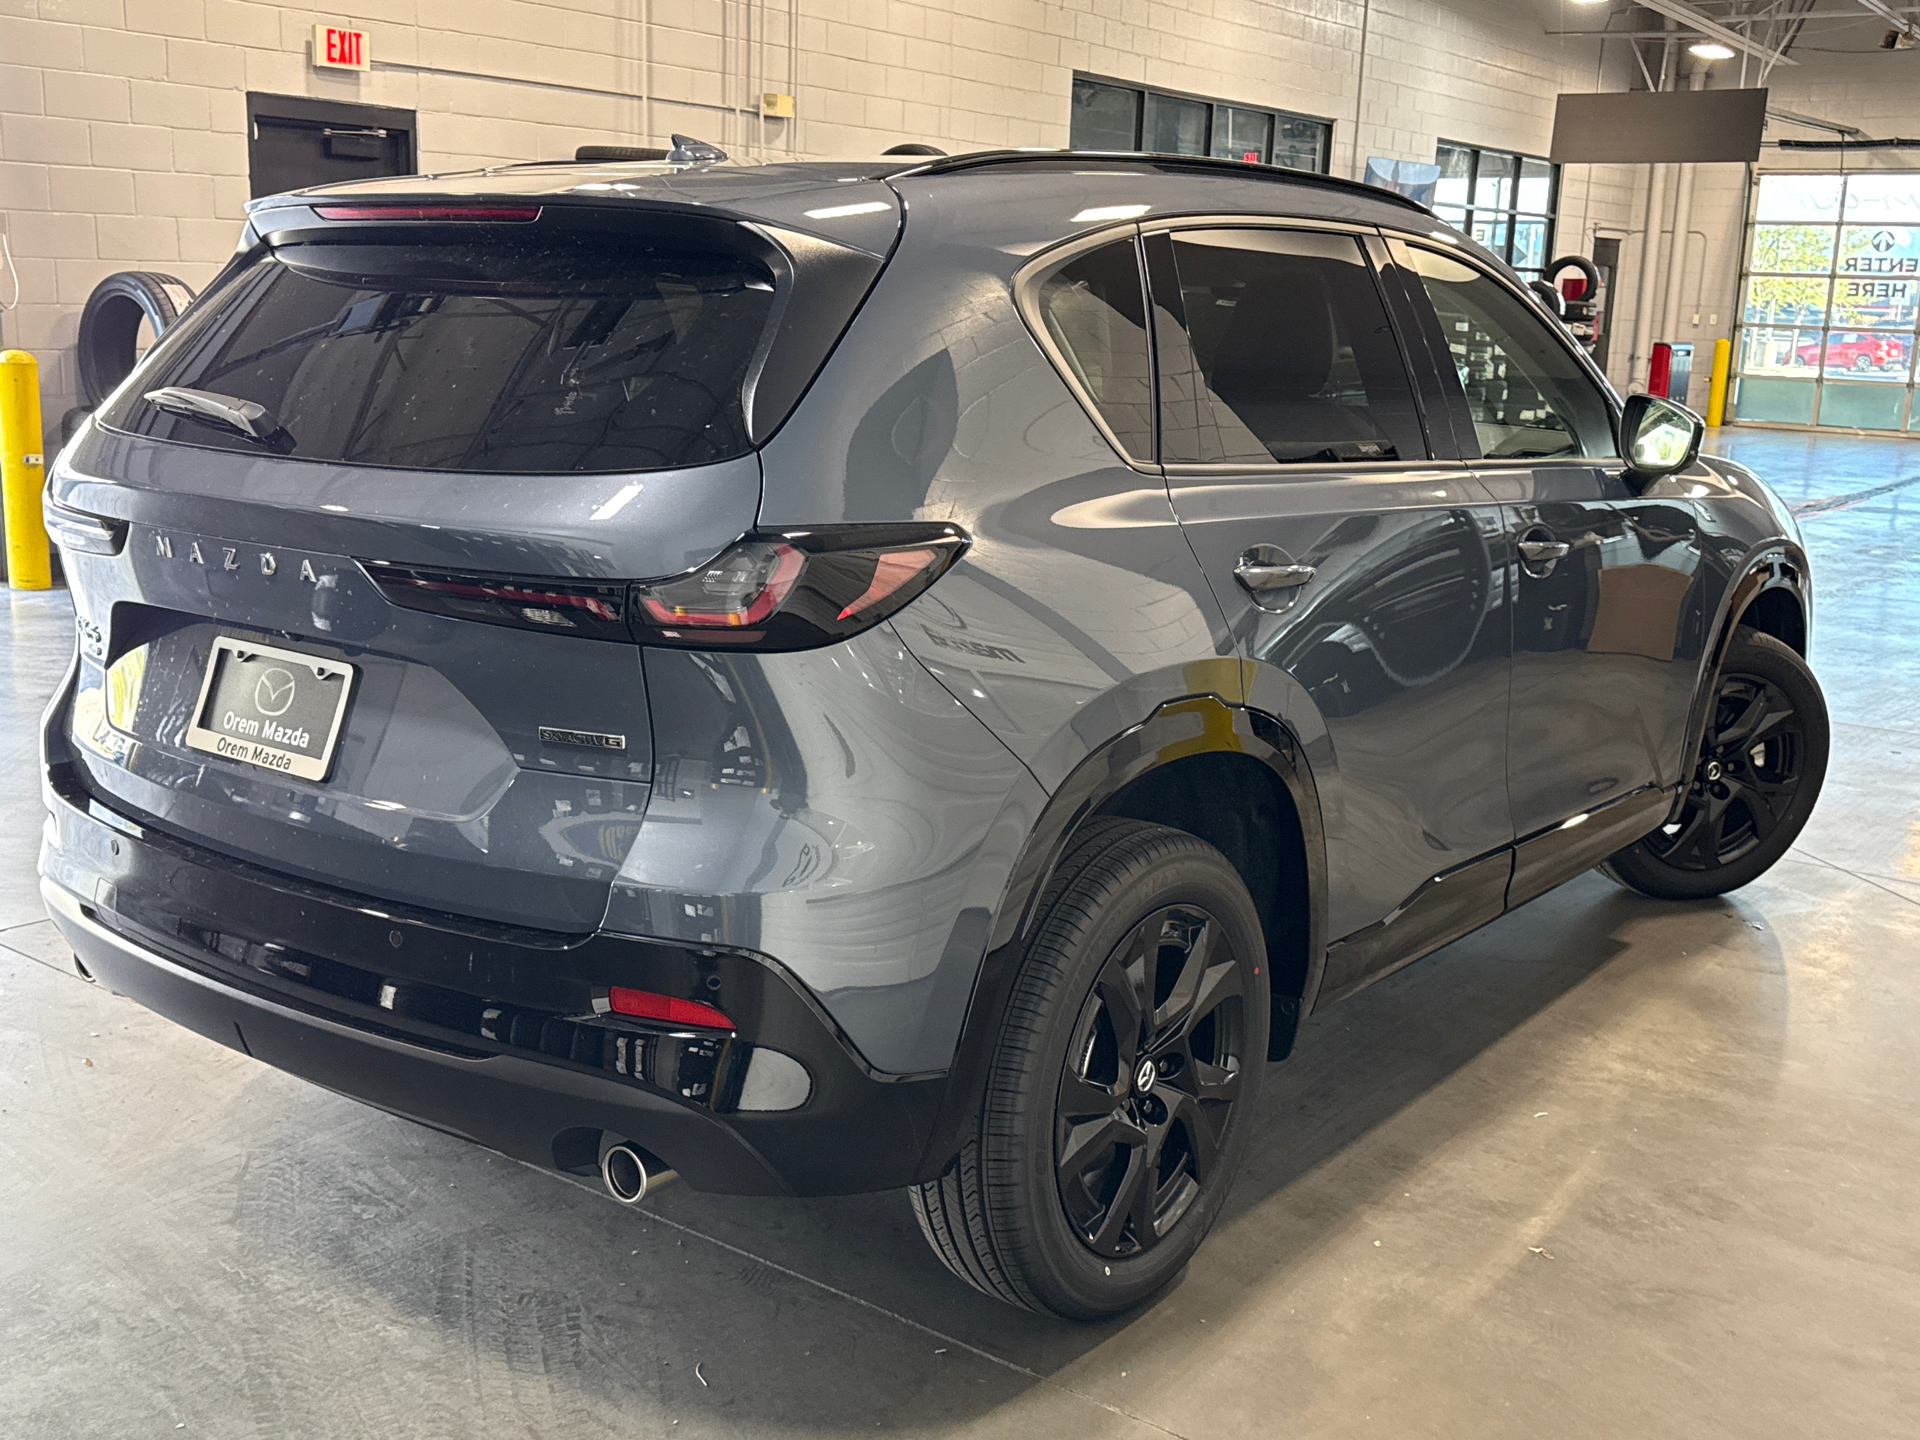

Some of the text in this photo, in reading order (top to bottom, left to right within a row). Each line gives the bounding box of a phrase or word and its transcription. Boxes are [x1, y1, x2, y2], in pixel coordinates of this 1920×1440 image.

[326, 28, 362, 67] EXIT
[155, 535, 318, 583] MAZDA
[223, 711, 310, 748] Orem Mazda
[216, 737, 292, 770] Orem Mazda
